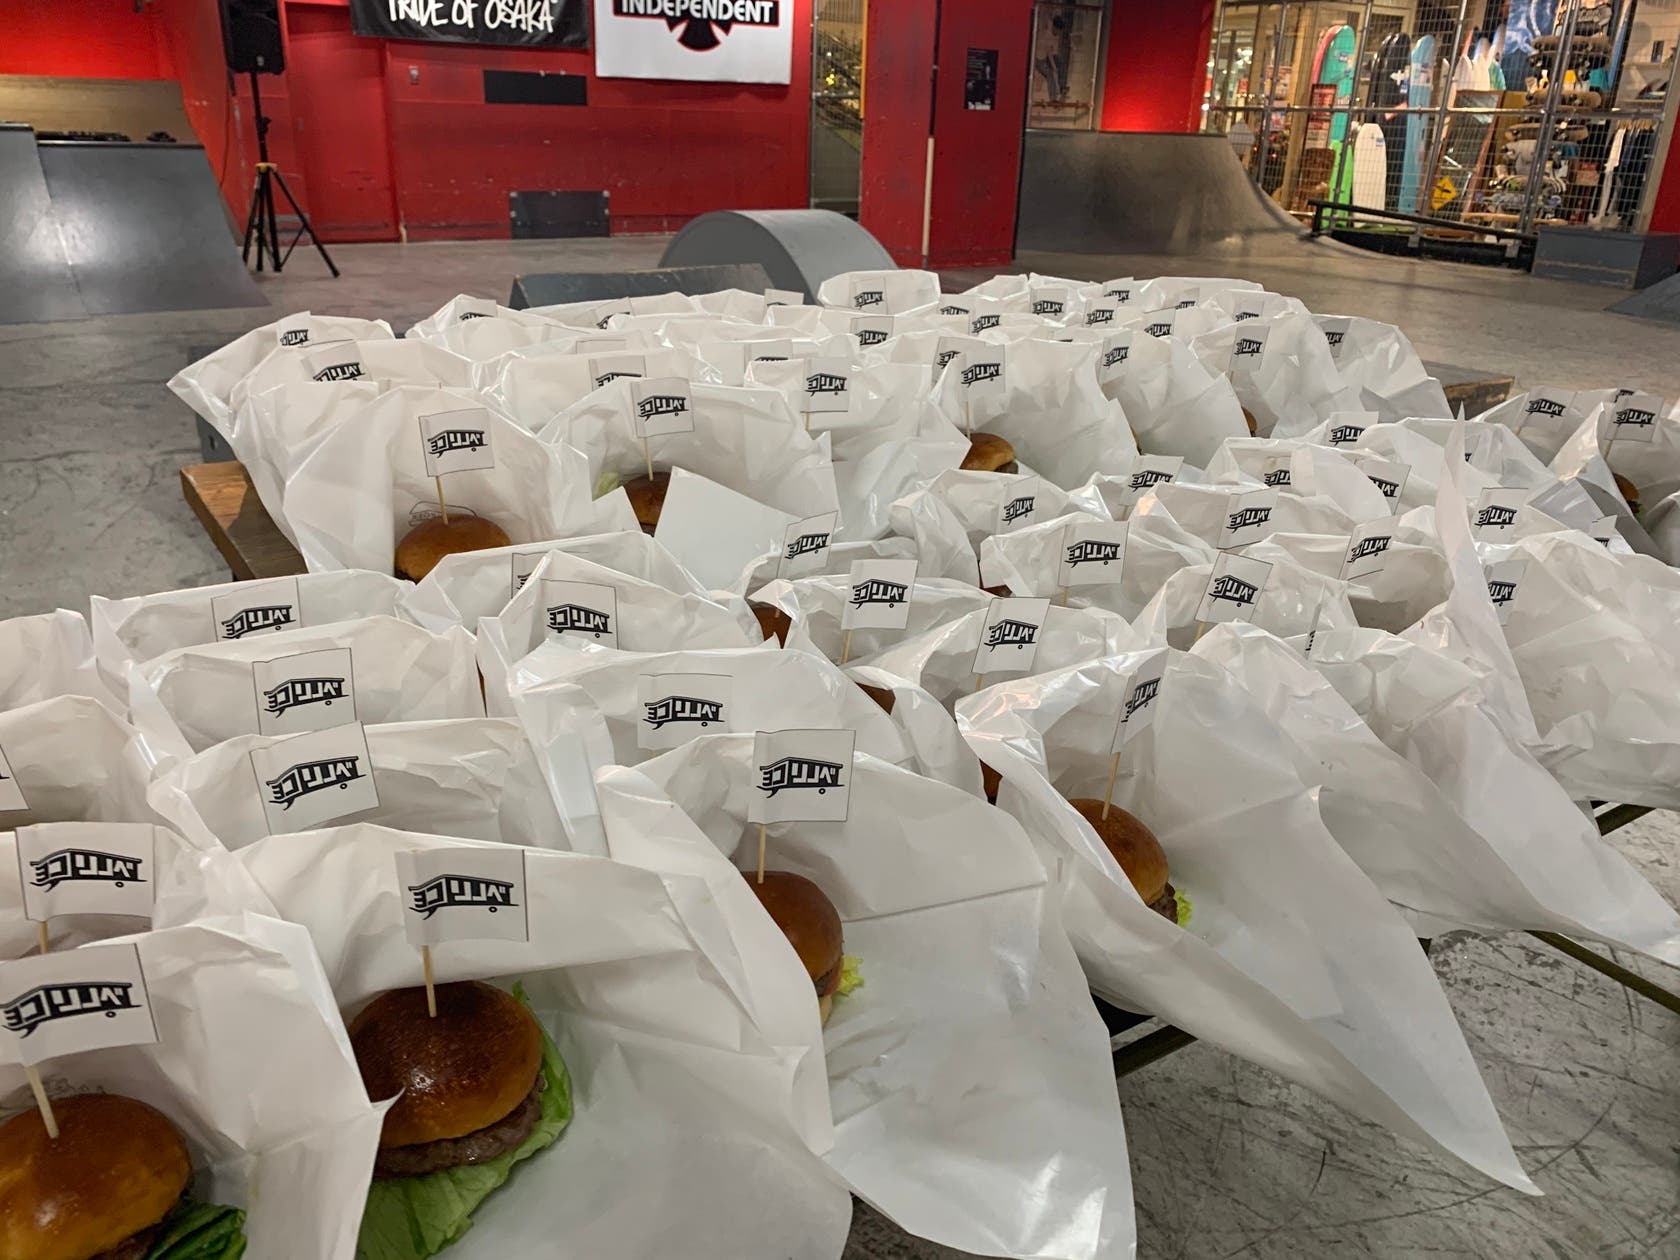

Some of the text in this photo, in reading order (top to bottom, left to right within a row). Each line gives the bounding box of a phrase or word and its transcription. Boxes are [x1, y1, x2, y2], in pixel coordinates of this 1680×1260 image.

[451, 0, 479, 29] OF
[484, 0, 555, 33] OSAKA
[622, 0, 774, 23] INDEPENDENT
